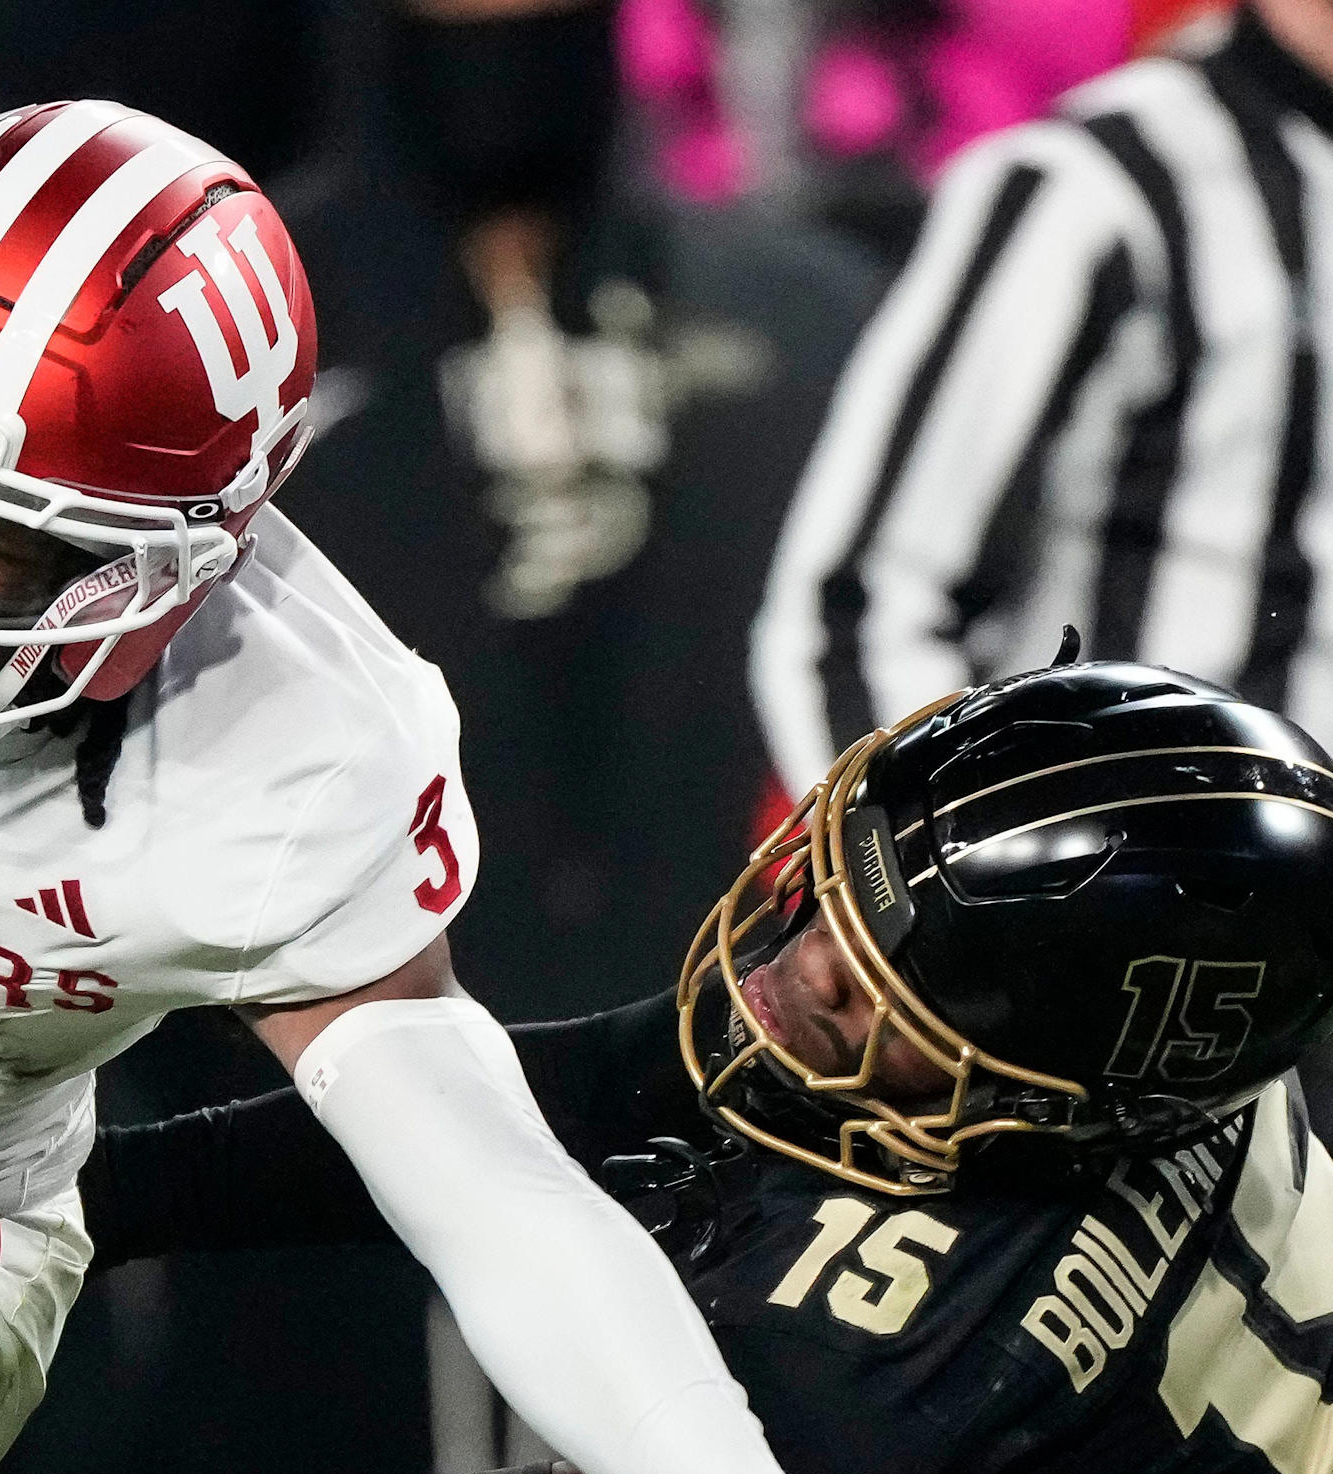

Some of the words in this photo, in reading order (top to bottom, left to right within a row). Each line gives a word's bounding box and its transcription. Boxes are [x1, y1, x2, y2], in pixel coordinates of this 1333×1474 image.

[407, 773, 462, 915] 3
[859, 828, 897, 913] PURDUE
[1103, 955, 1266, 1082] 15
[766, 1197, 960, 1335] 15
